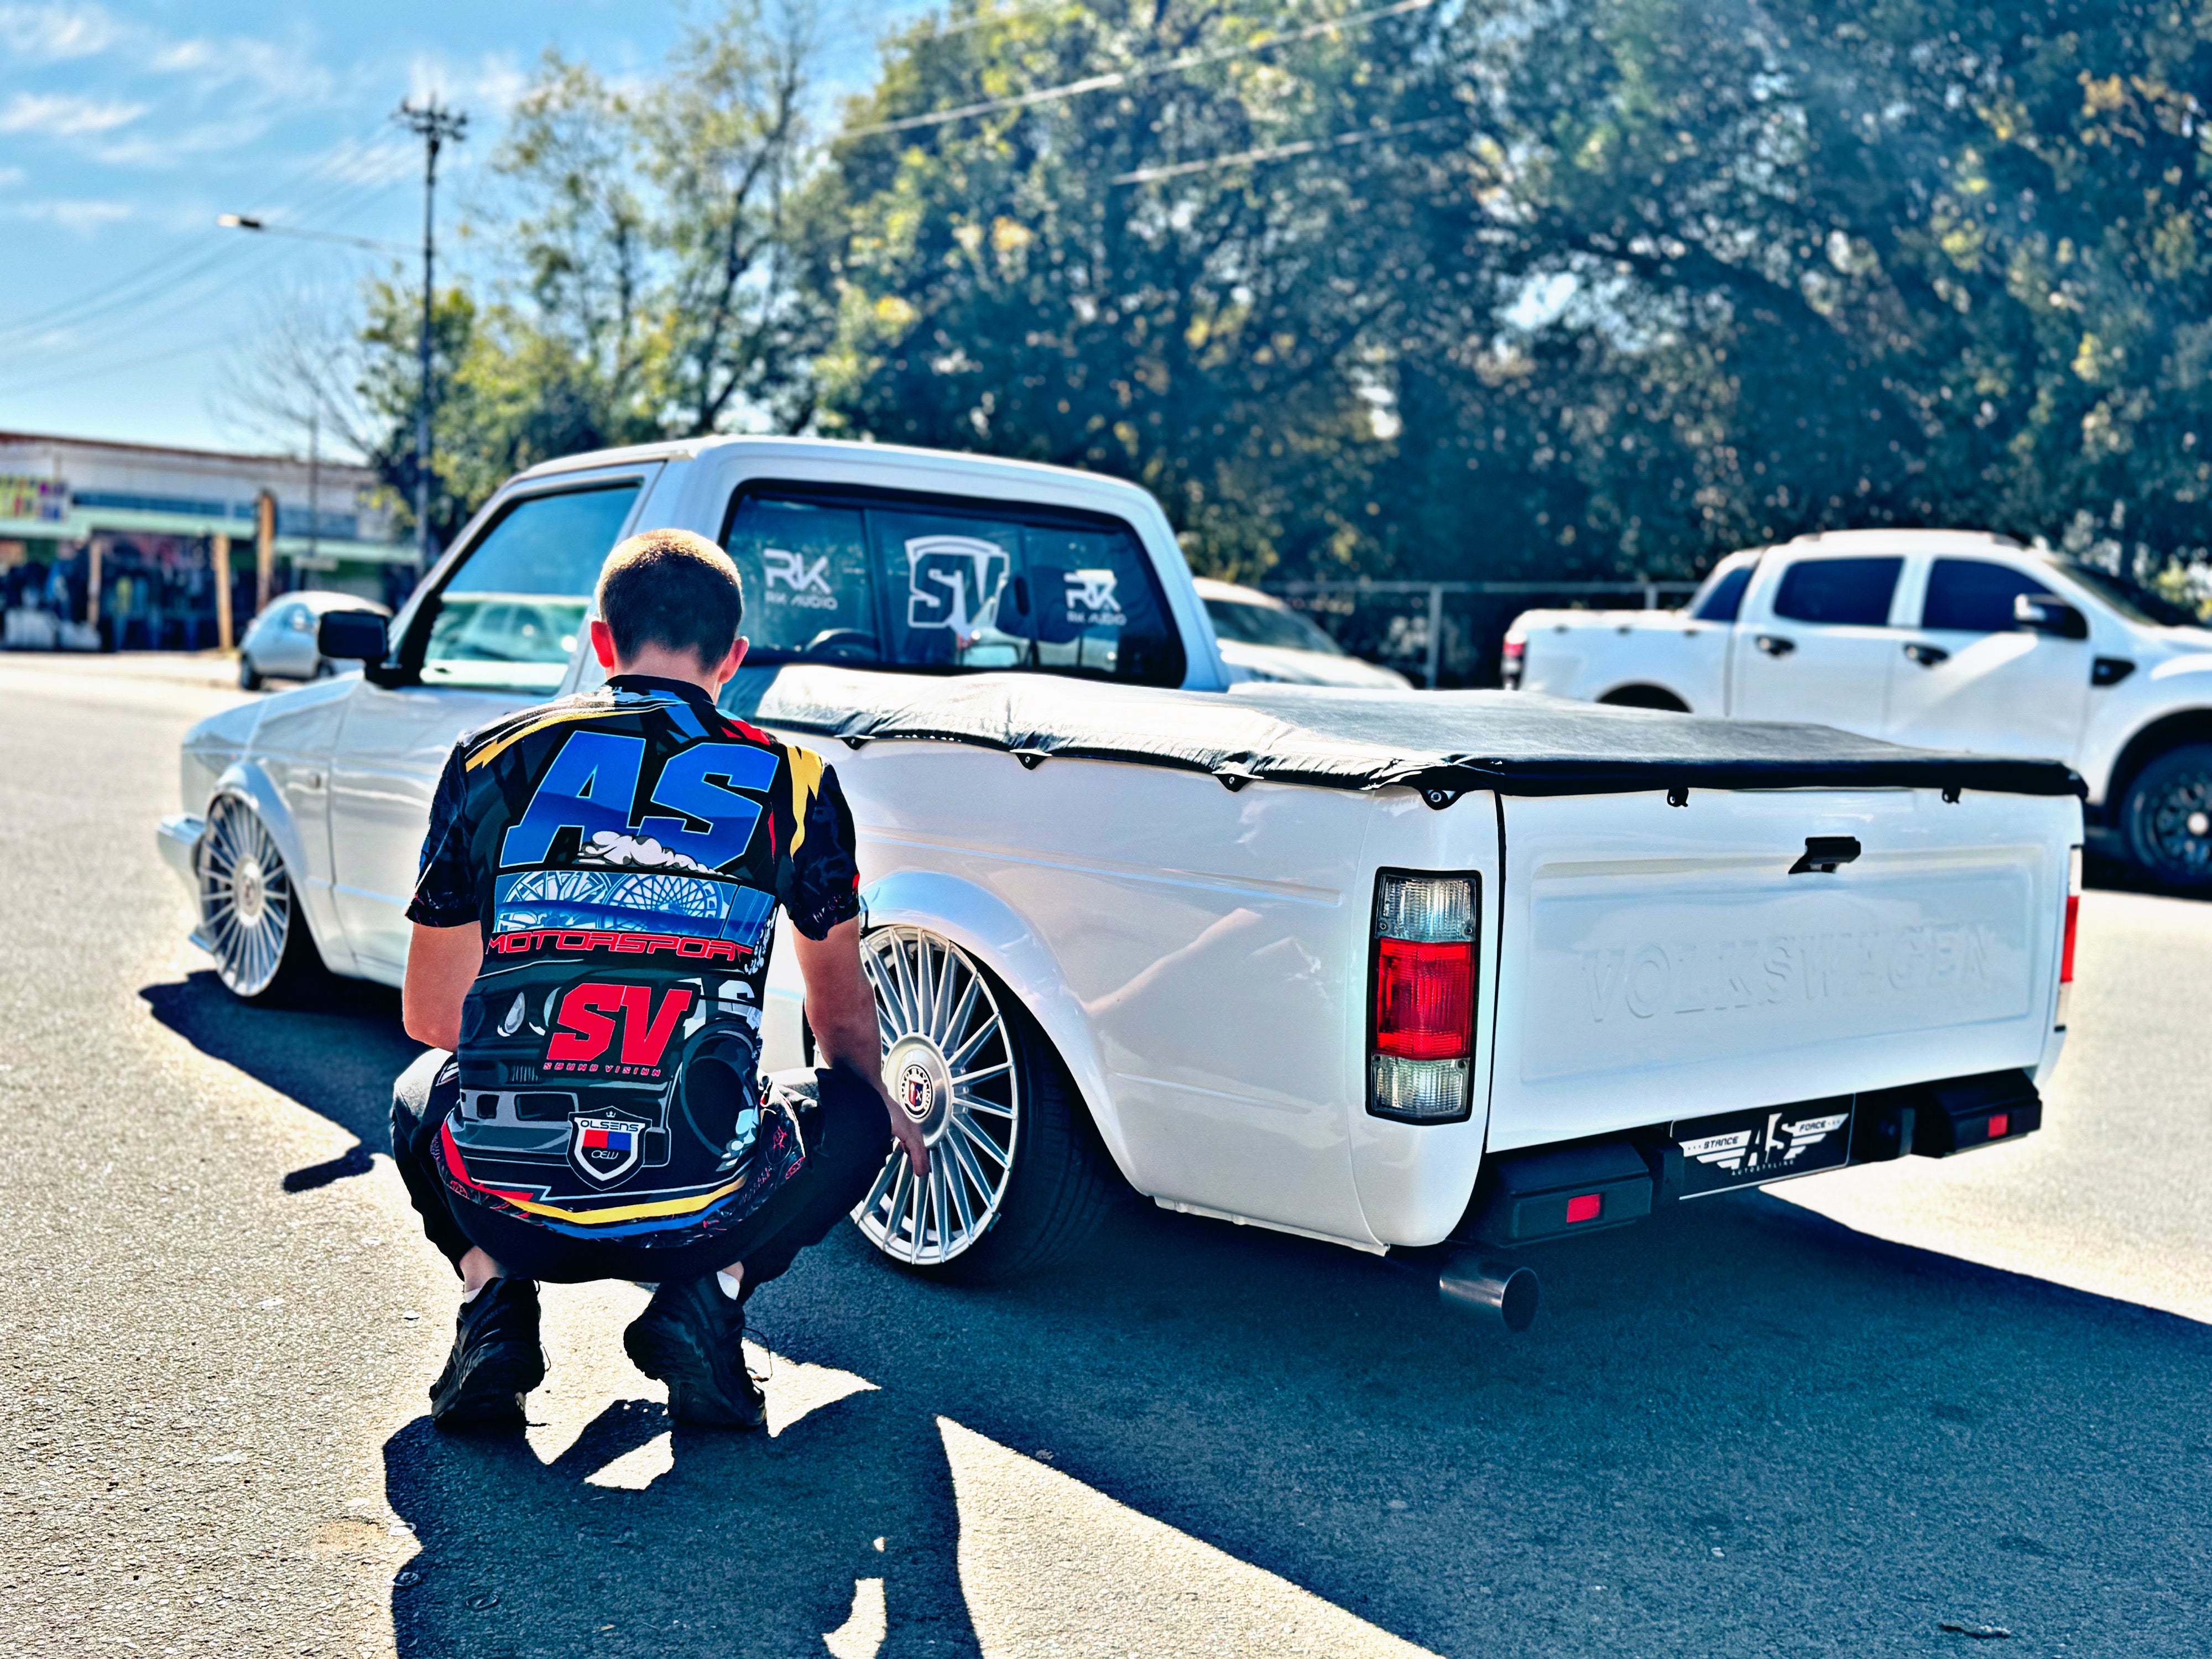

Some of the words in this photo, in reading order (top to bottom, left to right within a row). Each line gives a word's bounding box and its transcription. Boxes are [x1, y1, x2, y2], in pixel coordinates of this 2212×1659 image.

[763, 547, 832, 594] RK
[906, 547, 1011, 632] SV
[790, 594, 838, 611] AUDIO
[500, 730, 780, 872] AS
[486, 929, 755, 962] MOTORSPORT
[1579, 921, 1994, 1021] VOLKSWAGEN
[547, 983, 693, 1067] SV
[543, 1062, 599, 1072] SOUND
[605, 1065, 661, 1077] VISION
[580, 1119, 639, 1132] OLSENS
[1703, 1135, 1739, 1149] STANCE
[1798, 1119, 1827, 1133] FORCE
